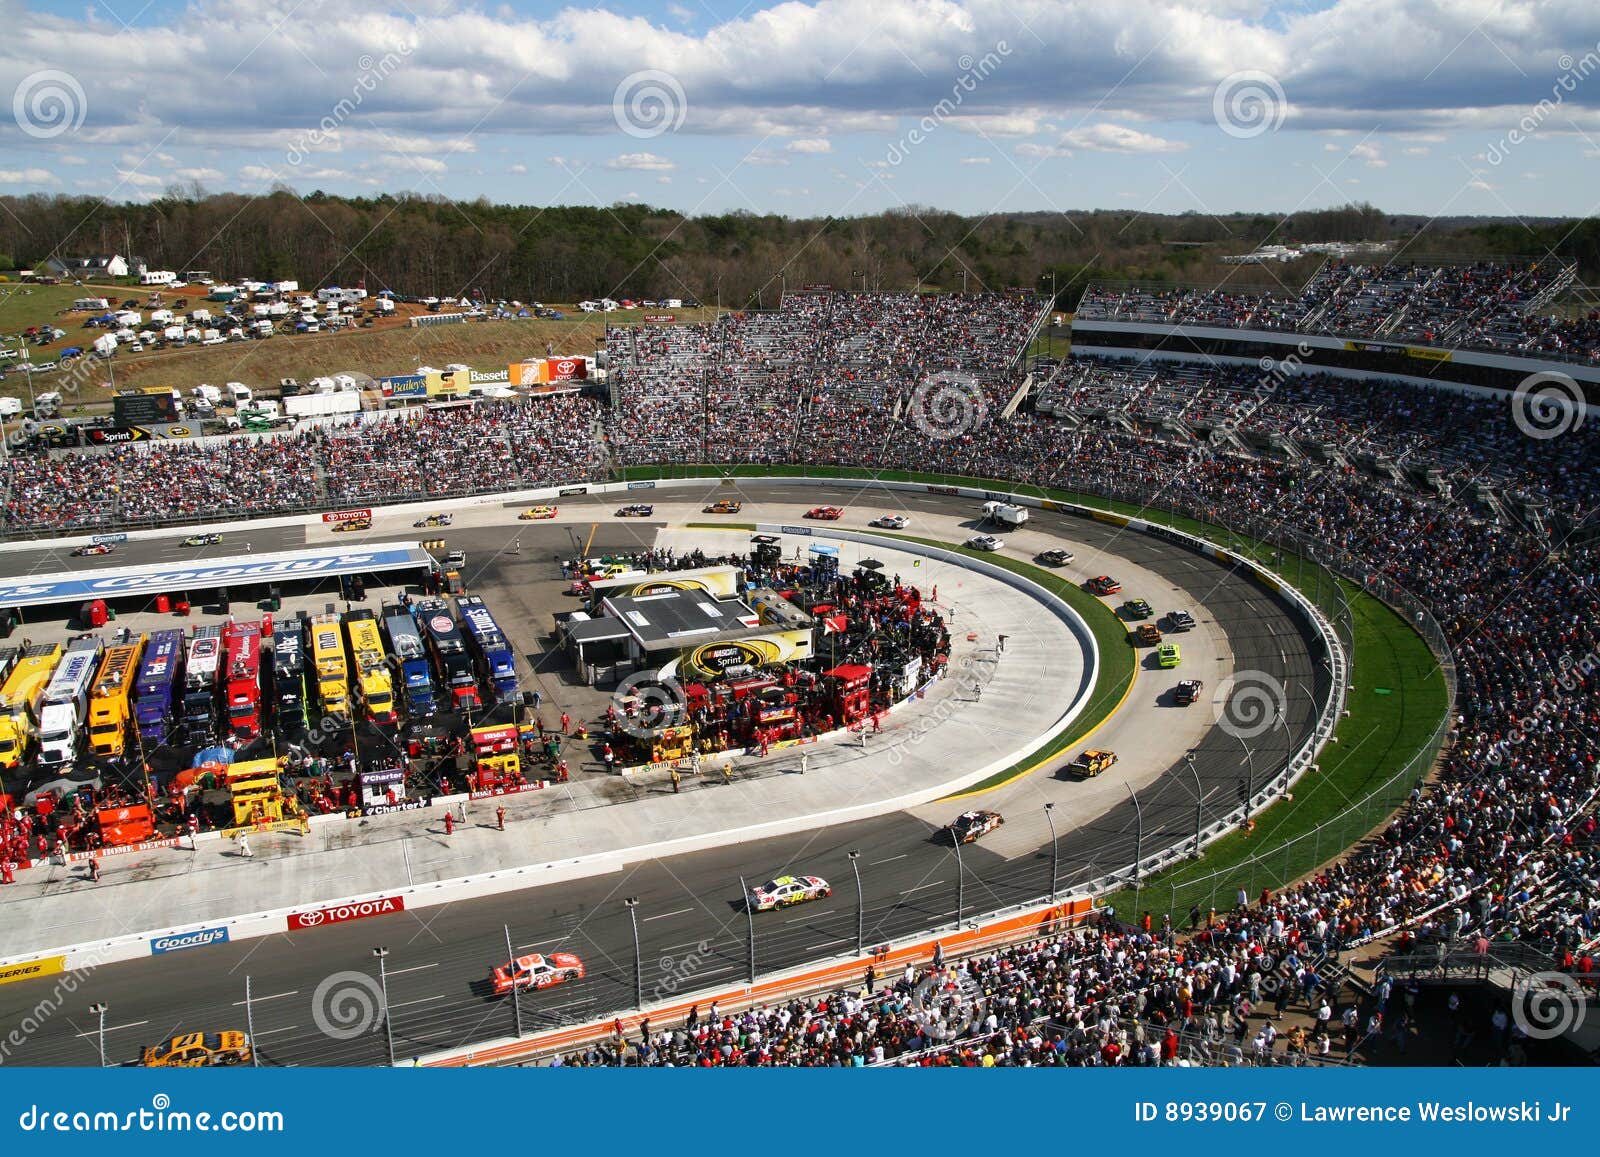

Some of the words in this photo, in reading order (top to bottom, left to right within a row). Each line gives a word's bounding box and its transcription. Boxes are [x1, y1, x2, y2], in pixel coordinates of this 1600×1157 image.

[471, 371, 508, 382] Bassett
[393, 376, 427, 393] Bailey's
[104, 431, 130, 442] Sprint
[338, 510, 369, 520] TOYOTA
[92, 554, 376, 590] Goody's
[713, 647, 739, 658] NASCAR
[717, 655, 742, 667] Sprint
[369, 772, 402, 783] Charter
[375, 802, 418, 815] Charter
[102, 844, 134, 857] HOME
[139, 838, 178, 850] DEPOT
[326, 899, 395, 921] TOYOTA
[155, 928, 225, 950] Goody's
